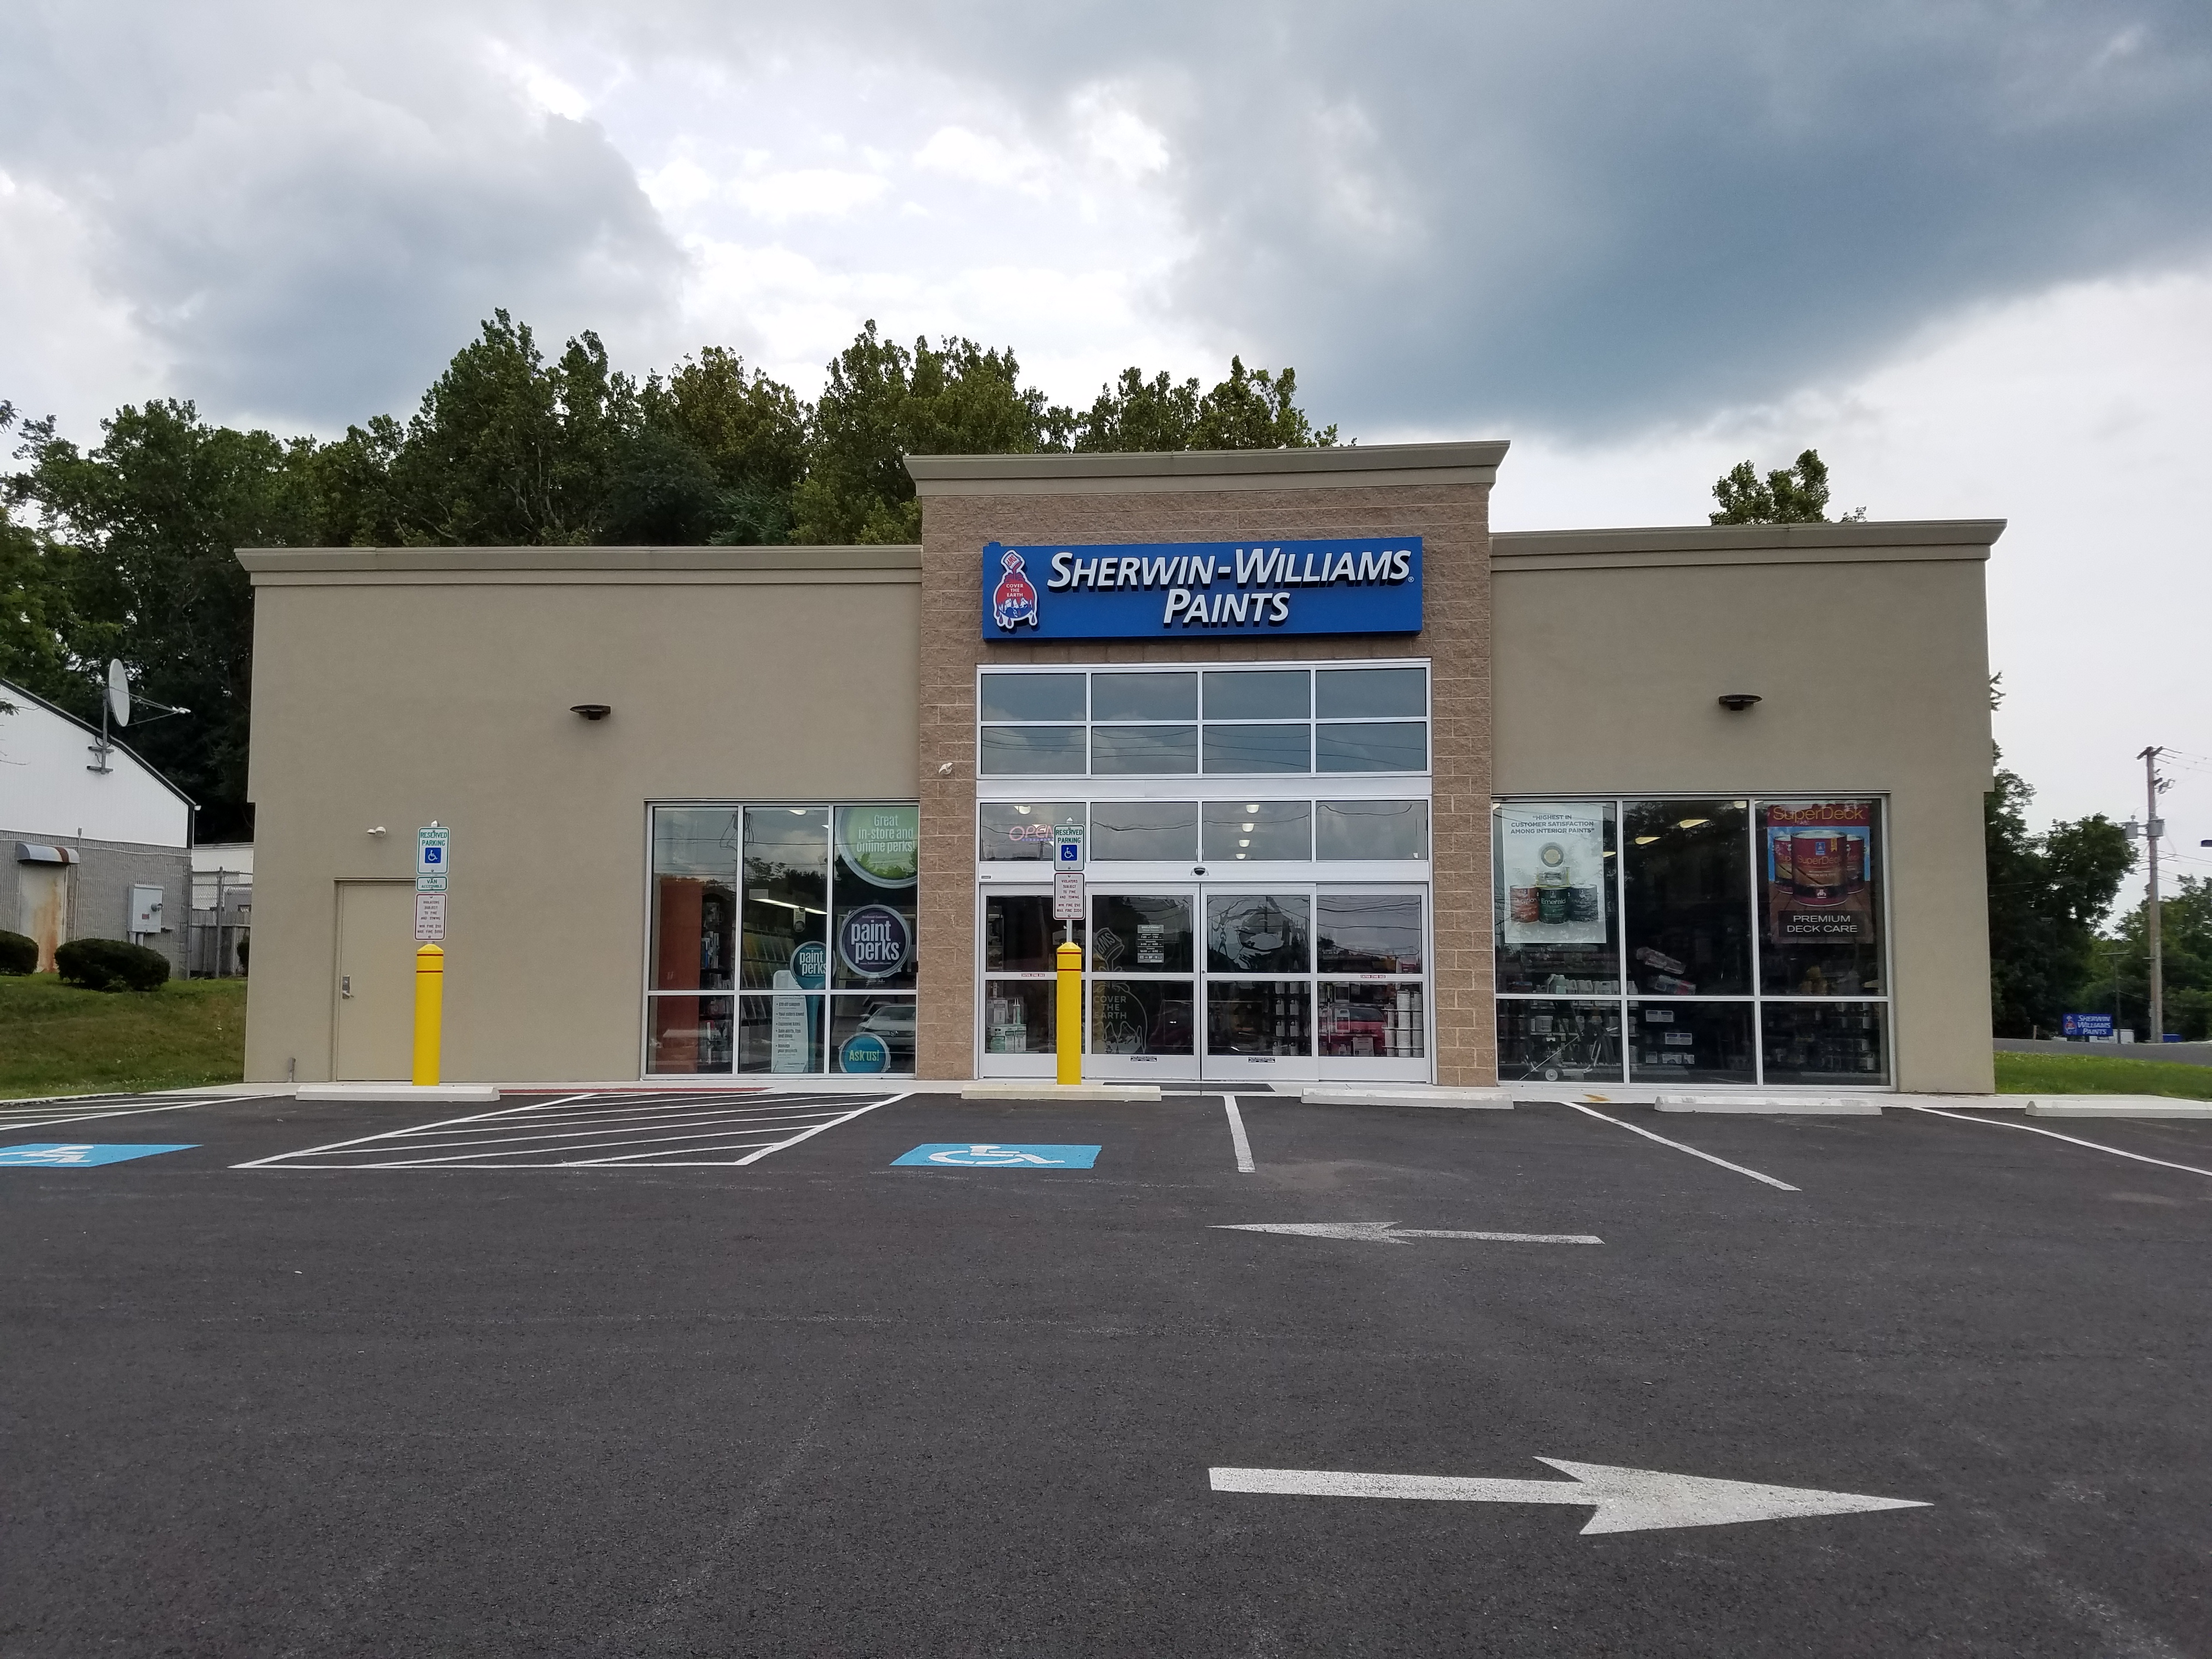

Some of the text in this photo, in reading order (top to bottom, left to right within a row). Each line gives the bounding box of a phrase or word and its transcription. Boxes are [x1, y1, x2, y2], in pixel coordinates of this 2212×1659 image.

[1006, 555, 1017, 567] SWP
[1047, 548, 1412, 588] SHERWIN-WILLIAMS
[1163, 589, 1290, 623] PAINTS
[874, 815, 898, 826] Great
[1773, 806, 1863, 823] SuperDeck
[859, 827, 913, 839] in-store and
[857, 840, 915, 854] online perks!
[851, 919, 891, 945] paint
[855, 939, 900, 963] perks
[1098, 933, 1115, 954] SWP
[799, 950, 823, 965] paint
[802, 961, 827, 975] perks
[849, 1049, 879, 1062] Ask us!
